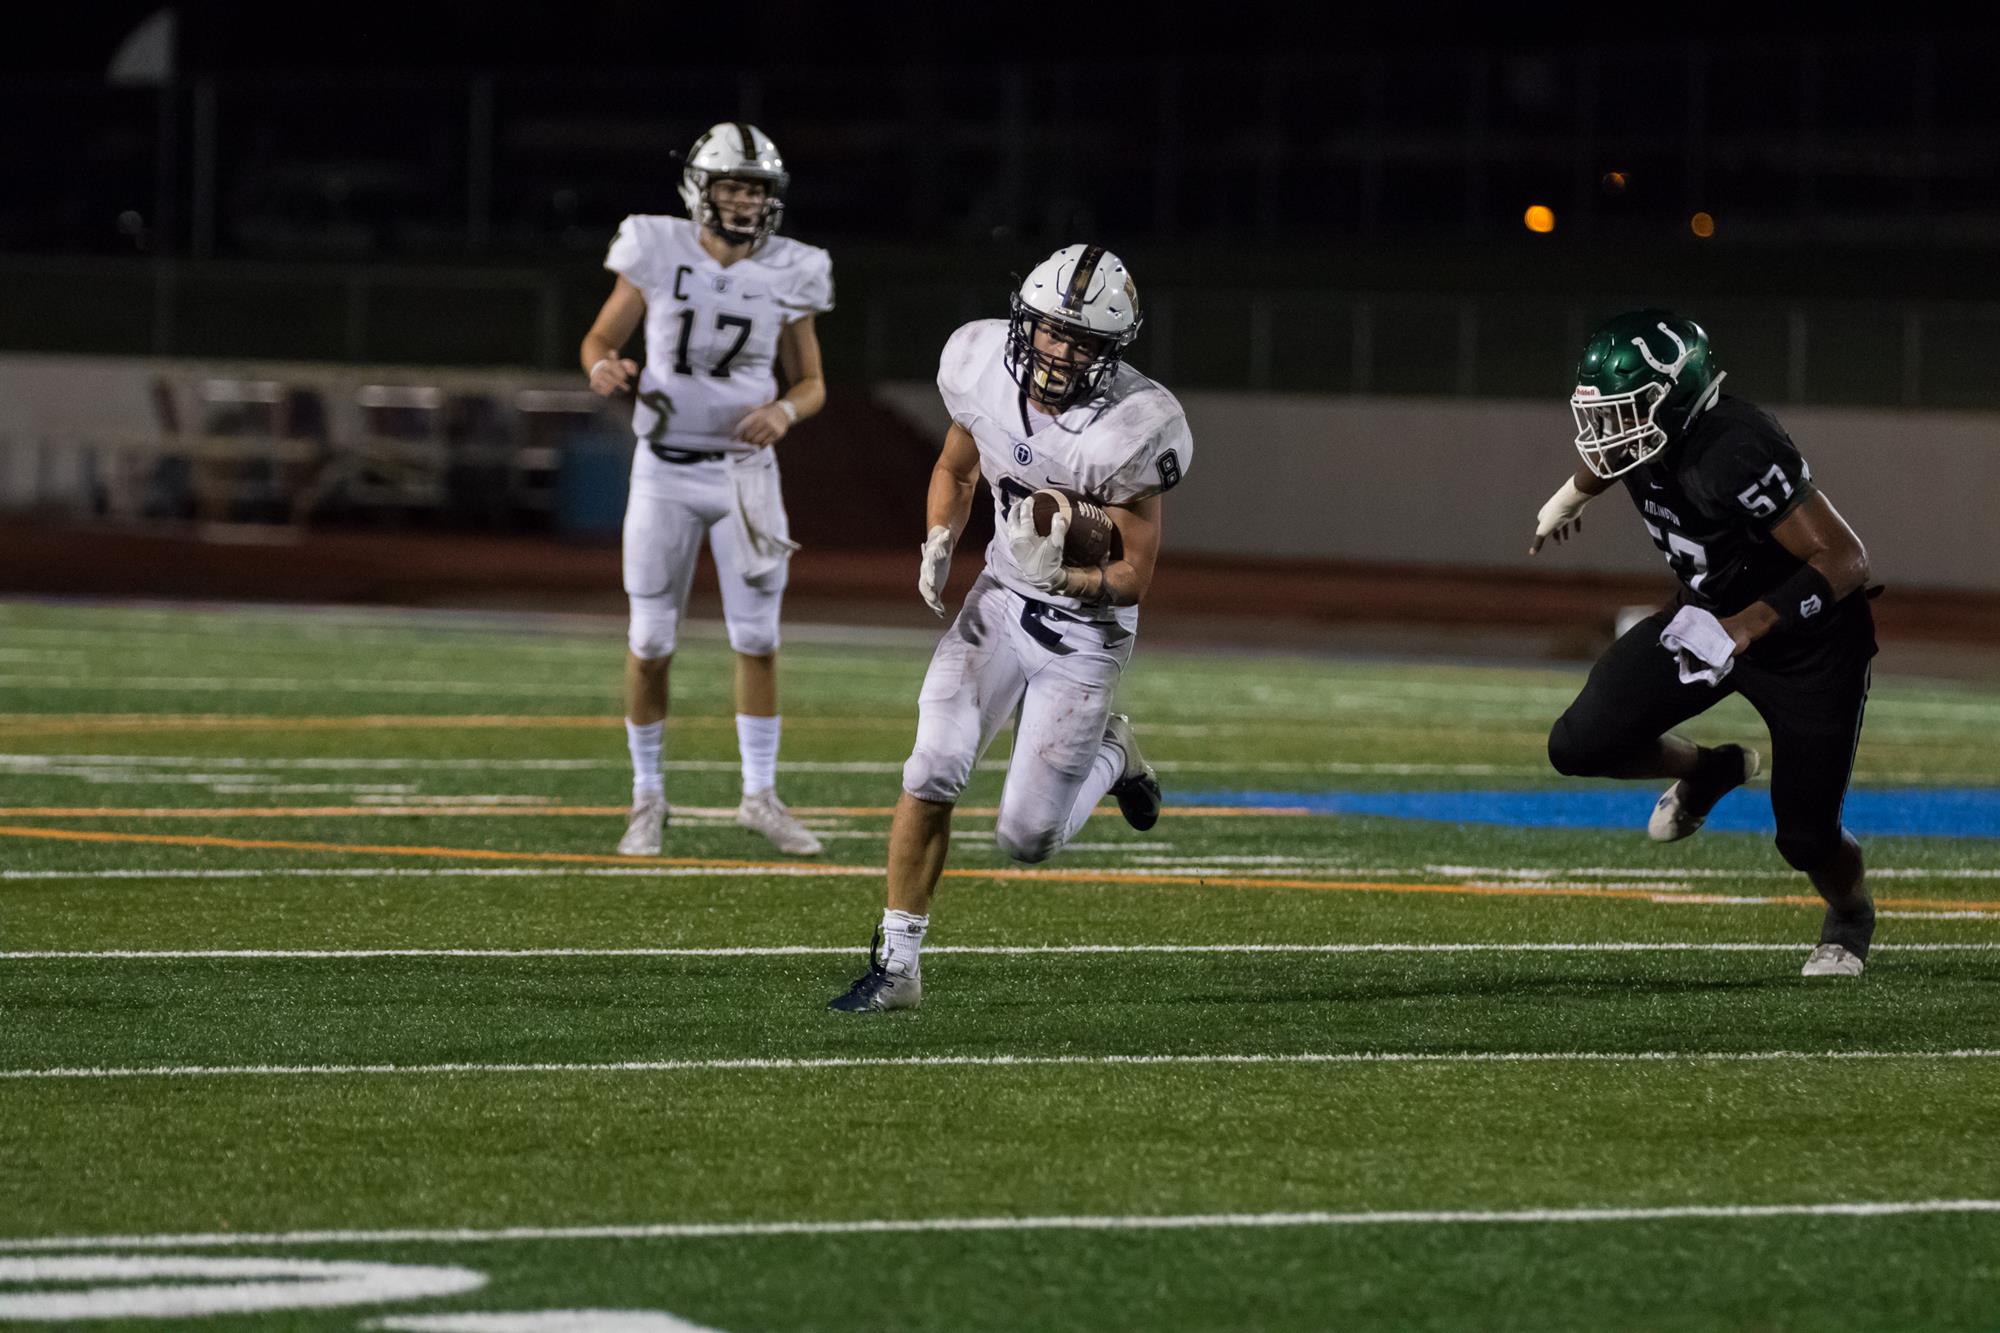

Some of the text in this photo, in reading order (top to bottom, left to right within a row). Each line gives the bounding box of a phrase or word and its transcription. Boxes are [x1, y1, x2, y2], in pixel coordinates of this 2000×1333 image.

[674, 265, 693, 301] C
[674, 309, 752, 377] 17
[1156, 448, 1182, 491] 8
[1737, 463, 1794, 518] 57
